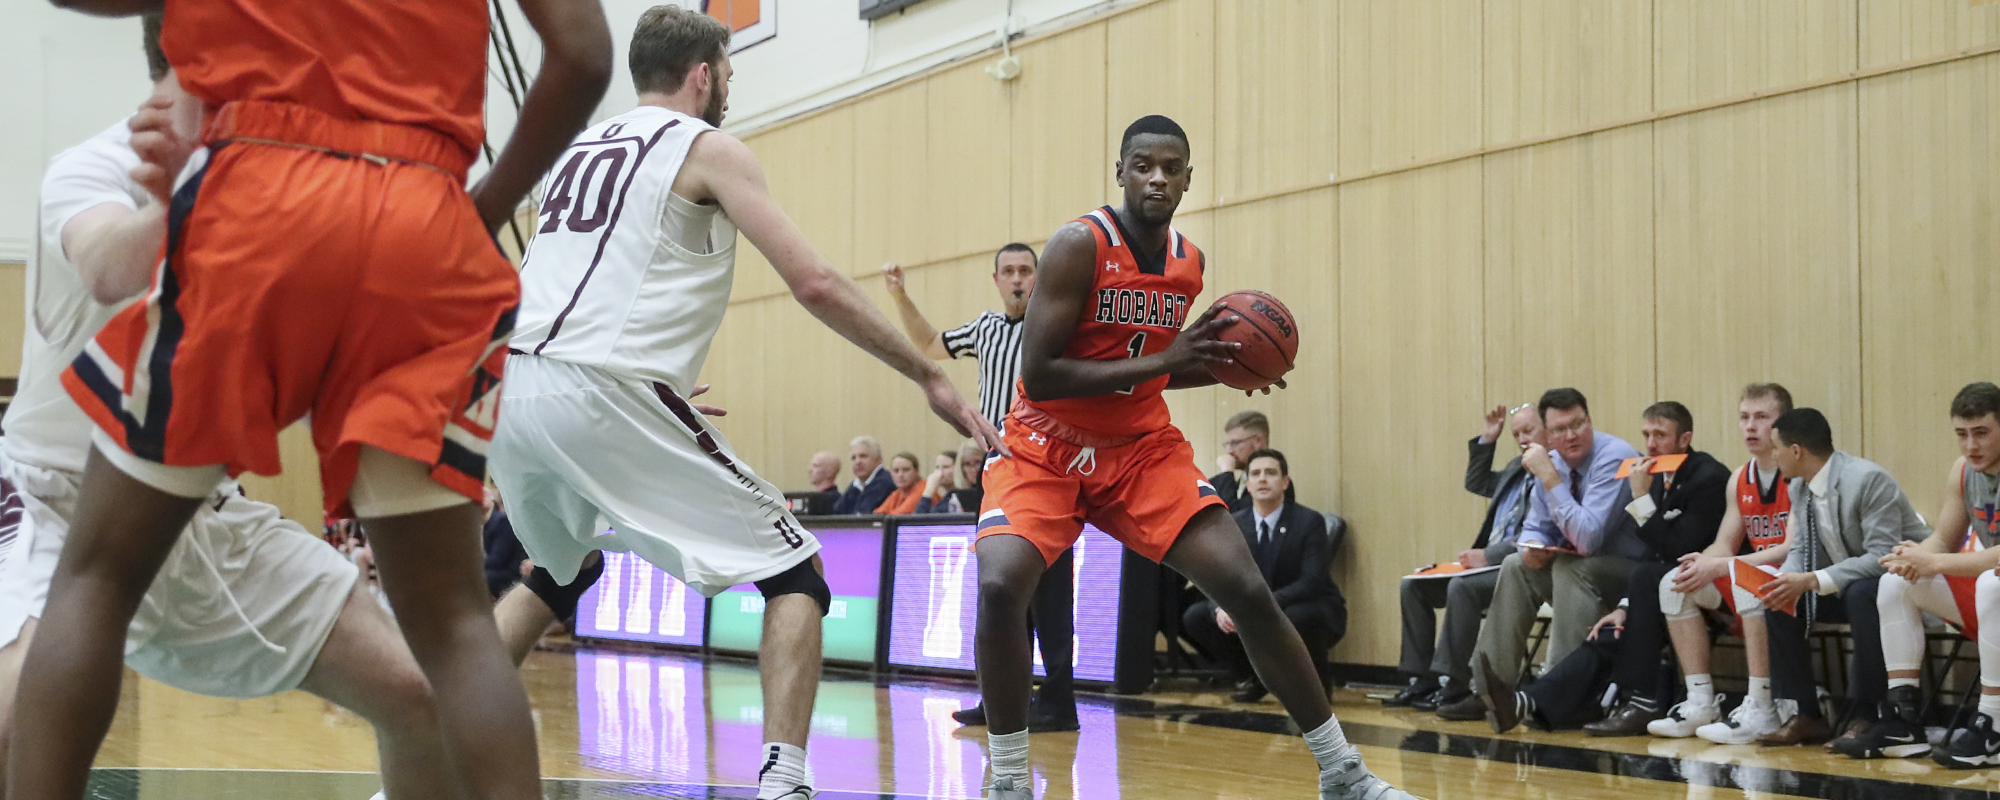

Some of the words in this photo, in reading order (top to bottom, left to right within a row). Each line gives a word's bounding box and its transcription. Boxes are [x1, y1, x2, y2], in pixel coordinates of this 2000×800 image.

[539, 146, 628, 234] 40
[1095, 288, 1187, 329] HOBART
[1250, 300, 1292, 339] NCAA
[773, 515, 804, 550] U
